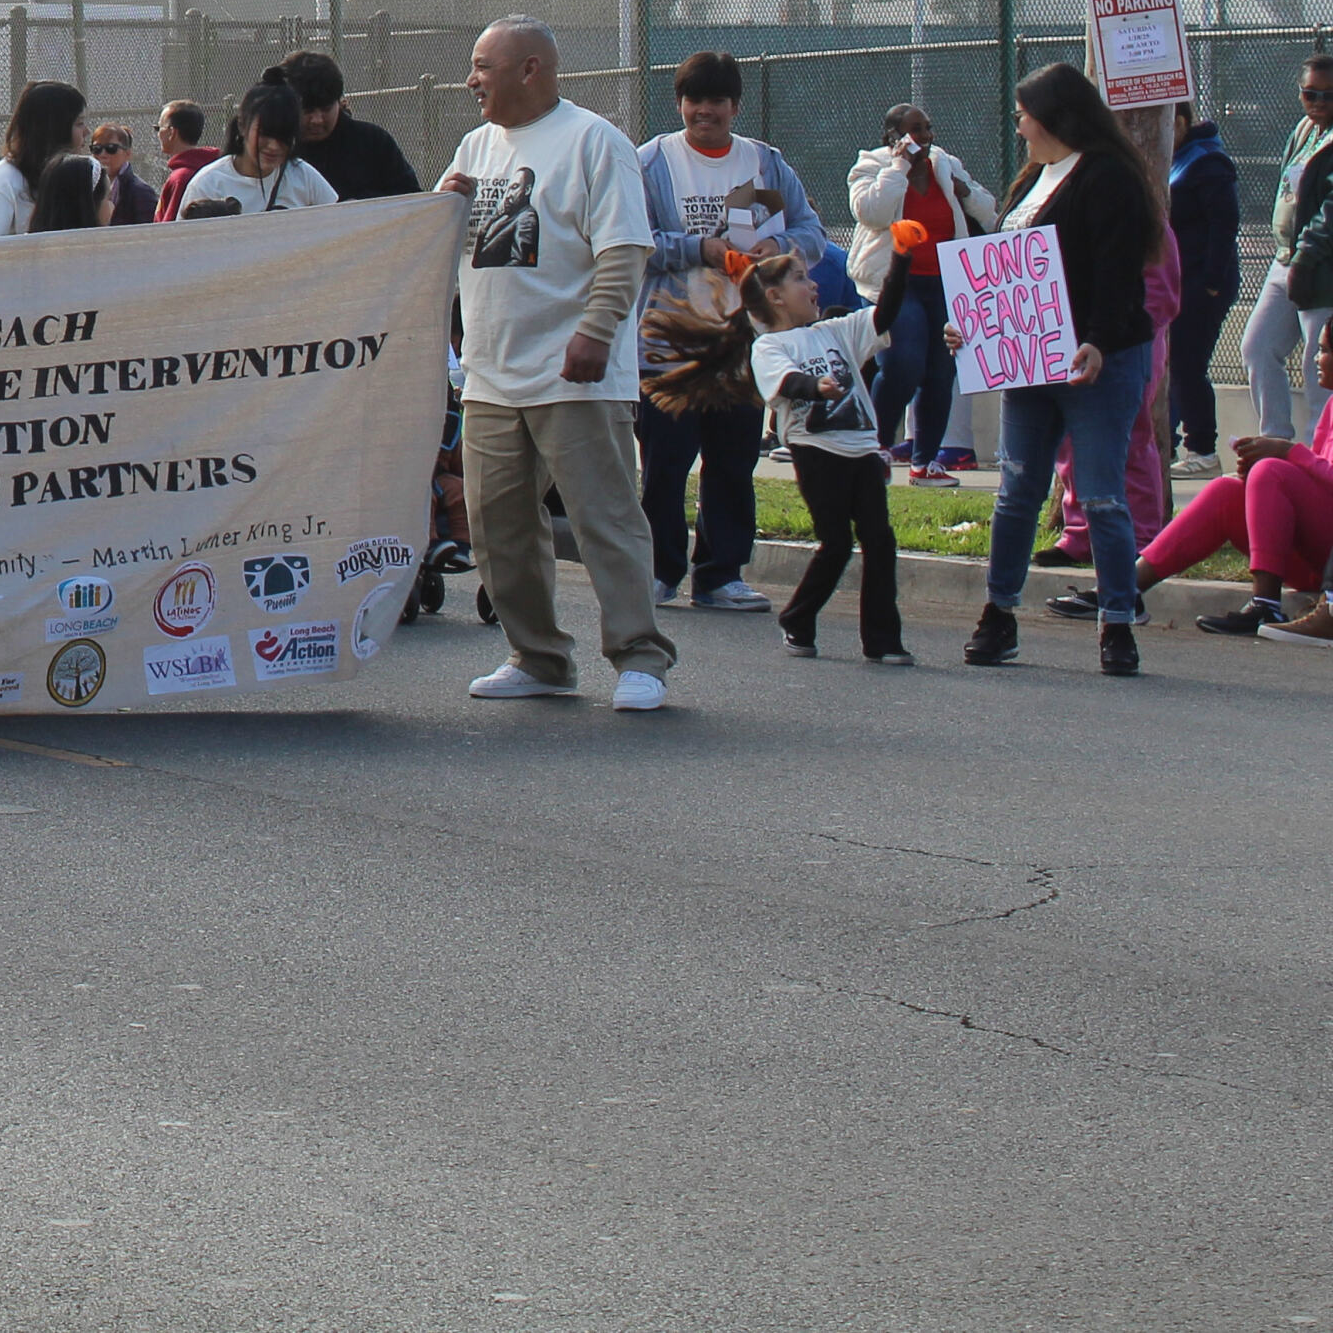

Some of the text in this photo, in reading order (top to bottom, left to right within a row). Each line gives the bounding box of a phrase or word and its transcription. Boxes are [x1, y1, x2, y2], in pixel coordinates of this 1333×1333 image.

[1118, 24, 1157, 36] SATURDAY
[492, 178, 510, 187] GOT
[481, 187, 507, 200] STAY
[709, 195, 724, 203] GOT
[684, 204, 725, 214] TO STAY
[958, 230, 1050, 293] LONG
[952, 280, 1064, 345] BEACH
[29, 332, 389, 400] INTERVENTION
[809, 356, 825, 366] GOT
[974, 330, 1068, 389] LOVE
[10, 453, 258, 507] PARTNERS
[91, 539, 173, 568] Martin
[246, 520, 293, 544] King
[302, 514, 332, 536] Jr.
[349, 538, 399, 553] LONG BEACH
[167, 606, 202, 617] LATINOS
[290, 623, 336, 636] Long Beach
[276, 638, 336, 662] Action
